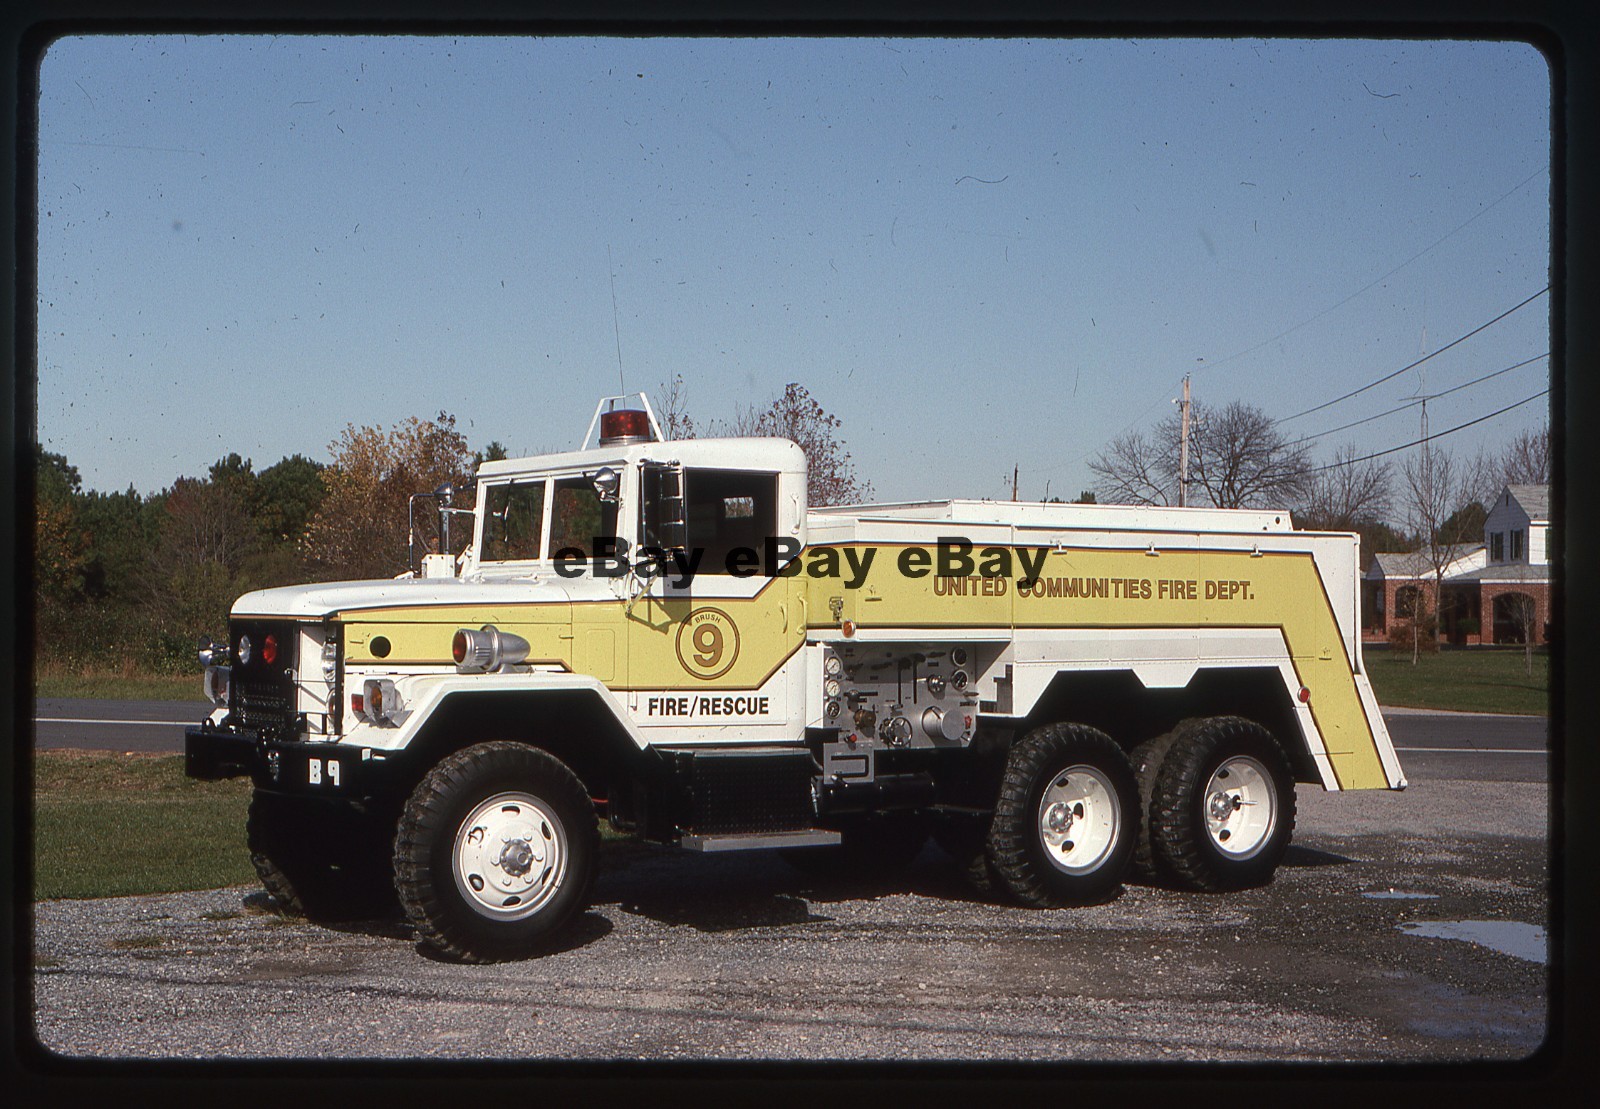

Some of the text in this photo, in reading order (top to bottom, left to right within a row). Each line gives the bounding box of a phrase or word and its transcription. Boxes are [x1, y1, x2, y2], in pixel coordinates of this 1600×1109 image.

[933, 574, 1255, 601] UNITED COMMUNITIES FIRE DEPT.
[694, 613, 721, 624] BRUSH
[692, 623, 724, 668] 9
[648, 695, 769, 718] FIRE/RESCUE
